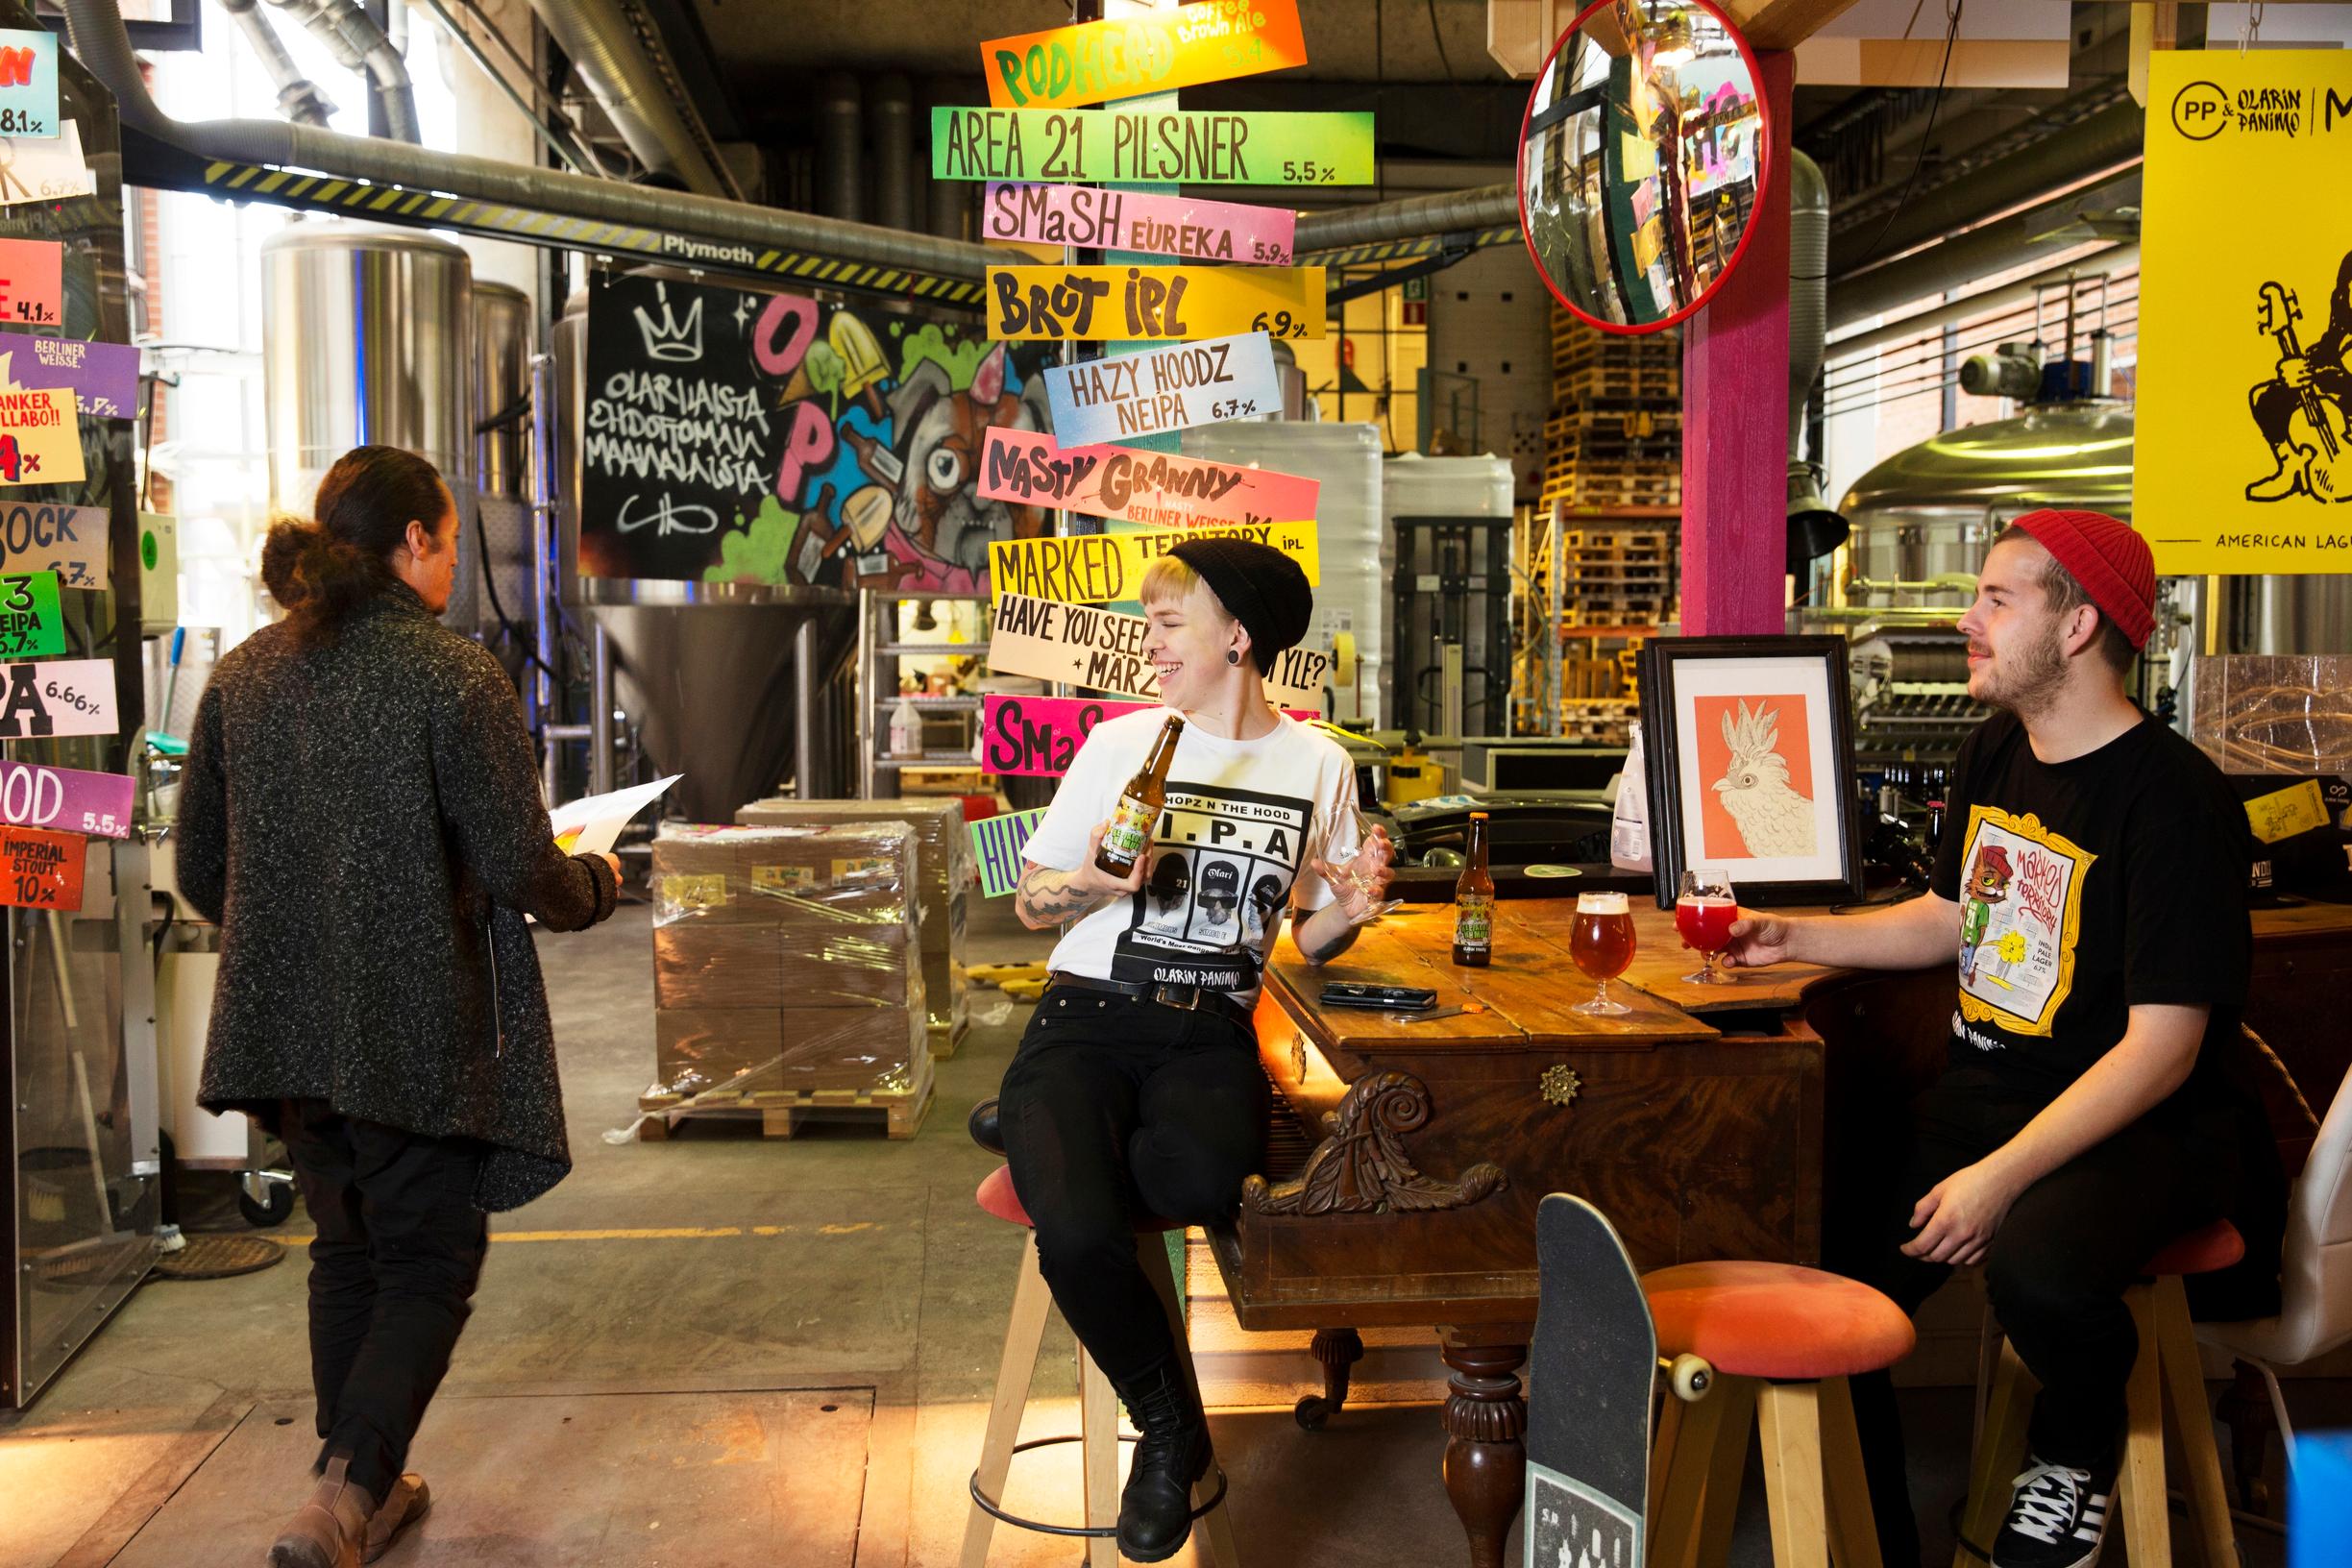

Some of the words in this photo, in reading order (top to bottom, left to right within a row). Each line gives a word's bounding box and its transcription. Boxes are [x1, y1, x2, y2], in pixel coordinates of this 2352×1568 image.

[1235, 11, 1266, 35] Ale
[995, 24, 1175, 107] PODHEAD
[2184, 101, 2217, 121] PP
[946, 110, 1025, 178] AREA
[1041, 114, 1088, 179] 21
[1114, 114, 1249, 181] PILSNER
[992, 182, 1122, 247] SMaSH
[1130, 220, 1234, 259] EUREKA
[663, 234, 754, 265] Plymoth
[992, 272, 1110, 338] BRUT
[35, 339, 86, 358] BERLINER
[1067, 357, 1140, 407] HAZY
[1153, 343, 1234, 389] HOODZ
[1116, 392, 1189, 435] NEIPA
[1099, 454, 1245, 511] GRANNY
[1127, 504, 1182, 527] BERLINER
[2216, 533, 2306, 550] AMERICAN
[2315, 533, 2352, 550] LAG
[997, 536, 1123, 601] MARKED
[998, 594, 1059, 642] HAVE
[1062, 605, 1099, 648] YOU
[0, 663, 53, 736] A
[0, 765, 63, 824] OD
[1165, 796, 1201, 808] HOPZ
[1207, 800, 1216, 810] N
[1221, 803, 1248, 815] THE
[1253, 807, 1290, 821] HOOD
[12, 858, 57, 875] STOUT
[1208, 868, 1234, 880] Olari
[14, 875, 56, 903] 10%
[1175, 878, 1188, 889] 21
[1140, 934, 1166, 945] World's
[2032, 955, 2052, 968] LAGER
[2037, 948, 2052, 960] PALE
